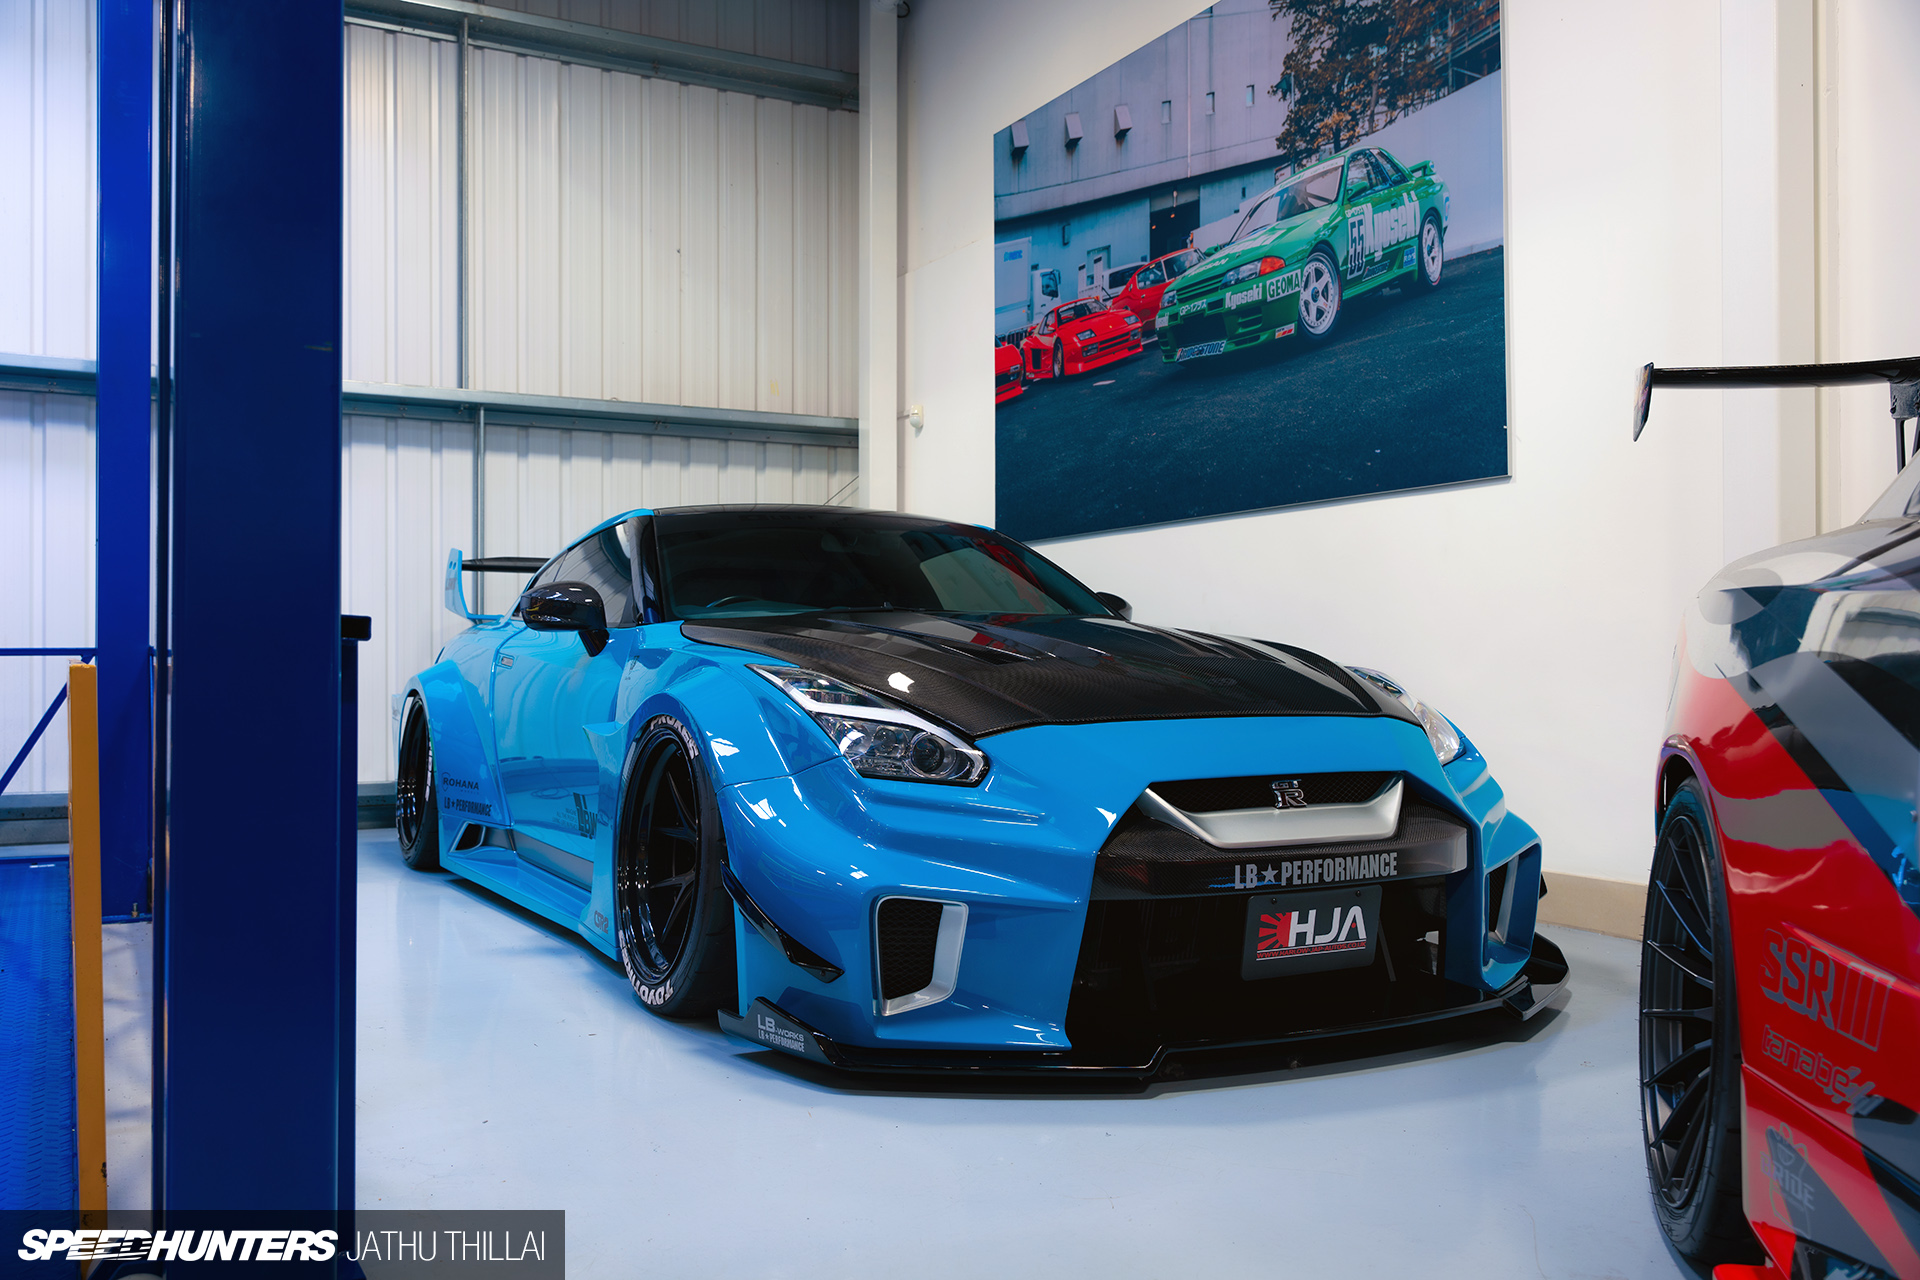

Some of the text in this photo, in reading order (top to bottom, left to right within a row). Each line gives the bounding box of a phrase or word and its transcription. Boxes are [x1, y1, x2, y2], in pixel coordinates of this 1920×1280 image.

[1348, 218, 1365, 277] 55
[1362, 190, 1420, 262] Kyoseki
[1225, 283, 1262, 310] Kyoseki
[1267, 272, 1300, 299] GEOMA
[442, 777, 480, 790] ROHANA
[456, 798, 492, 817] PERFORMANCE
[1280, 852, 1398, 886] PERFORMANCE
[1288, 905, 1367, 948] HJA
[1759, 927, 1836, 1031] SSR
[1762, 1023, 1851, 1102] tanabe
[1760, 1150, 1816, 1212] BRIDE
